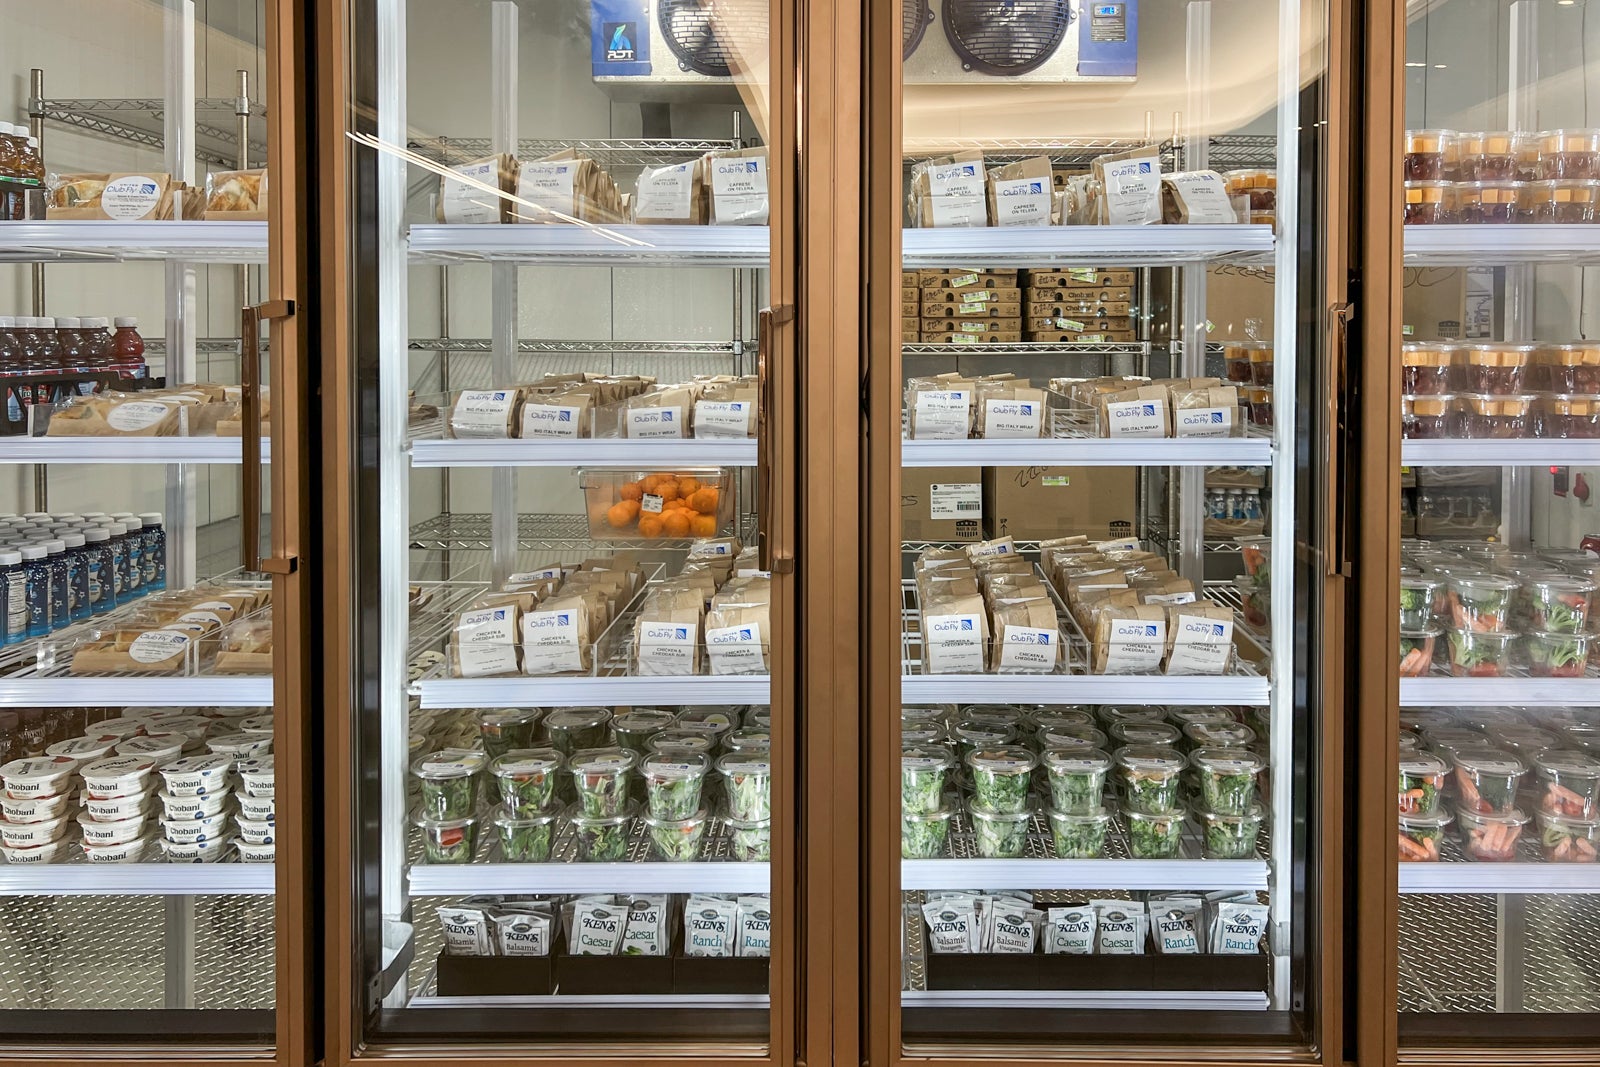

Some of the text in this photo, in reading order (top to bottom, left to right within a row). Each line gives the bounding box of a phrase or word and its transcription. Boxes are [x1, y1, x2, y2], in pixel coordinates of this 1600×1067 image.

[1127, 168, 1136, 176] Fly
[1018, 188, 1028, 196] Fly
[1186, 624, 1210, 634] Club Fly
[1026, 636, 1035, 644] Fly
[171, 780, 202, 788] Chobani
[5, 807, 35, 815] Chobani
[169, 804, 200, 812] Chobani
[4, 831, 33, 839] Chobani
[9, 854, 42, 862] Chobani
[93, 852, 127, 861] Chobani
[627, 912, 657, 923] KEN'S
[445, 924, 475, 936] KEN'S
[583, 918, 616, 932] KEN'S
[692, 920, 726, 933] KEN'S
[745, 920, 770, 931] KEN
[932, 921, 967, 933] KEN'S
[997, 923, 1030, 938] KEN'S
[1058, 921, 1090, 932] KEN'S
[1100, 923, 1135, 932] KEN'S
[1160, 920, 1195, 932] KEN'S
[1225, 924, 1258, 936] KEN'S
[505, 932, 539, 943] KEN'S
[625, 929, 655, 939] Caesar
[582, 935, 613, 947] Caesar
[693, 935, 722, 946] Ranch
[746, 936, 769, 948] Ranc
[936, 936, 966, 945] Balsamic
[997, 936, 1028, 948] Balsamic
[1056, 938, 1087, 946] Caesar
[1101, 938, 1134, 948] Caesar
[1165, 935, 1195, 949] Ranch
[1225, 939, 1255, 951] Ranch
